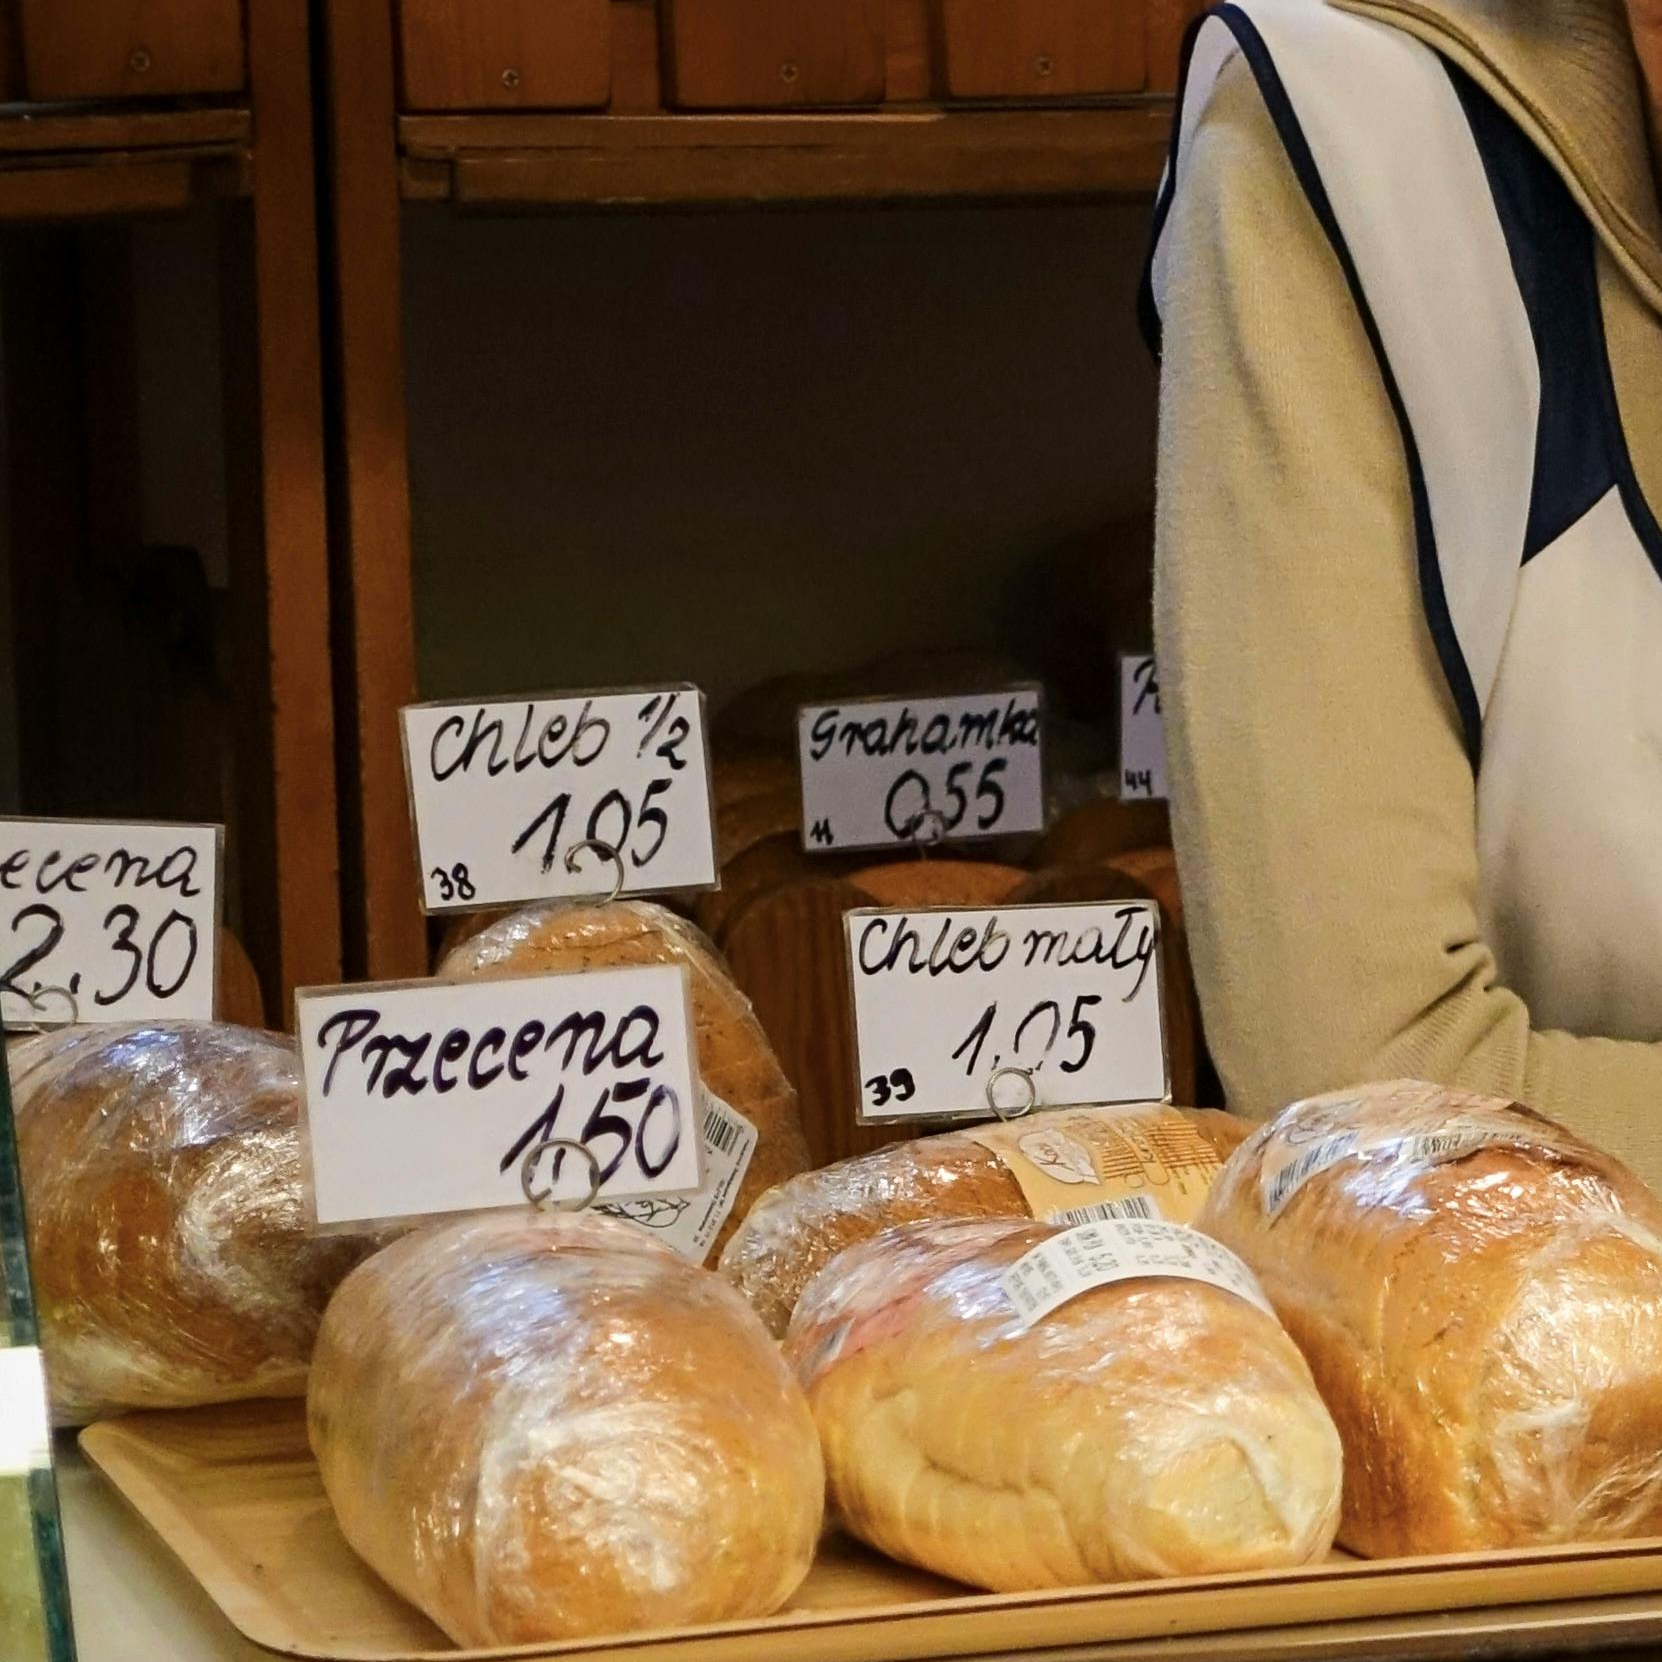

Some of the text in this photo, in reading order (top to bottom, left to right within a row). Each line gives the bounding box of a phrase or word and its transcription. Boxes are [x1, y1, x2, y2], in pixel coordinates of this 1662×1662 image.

[430, 700, 611, 782] Chleb
[430, 862, 476, 901] 38
[859, 915, 1010, 977] Chleb
[317, 1004, 665, 1099] Przecena
[864, 1067, 916, 1107] 39
